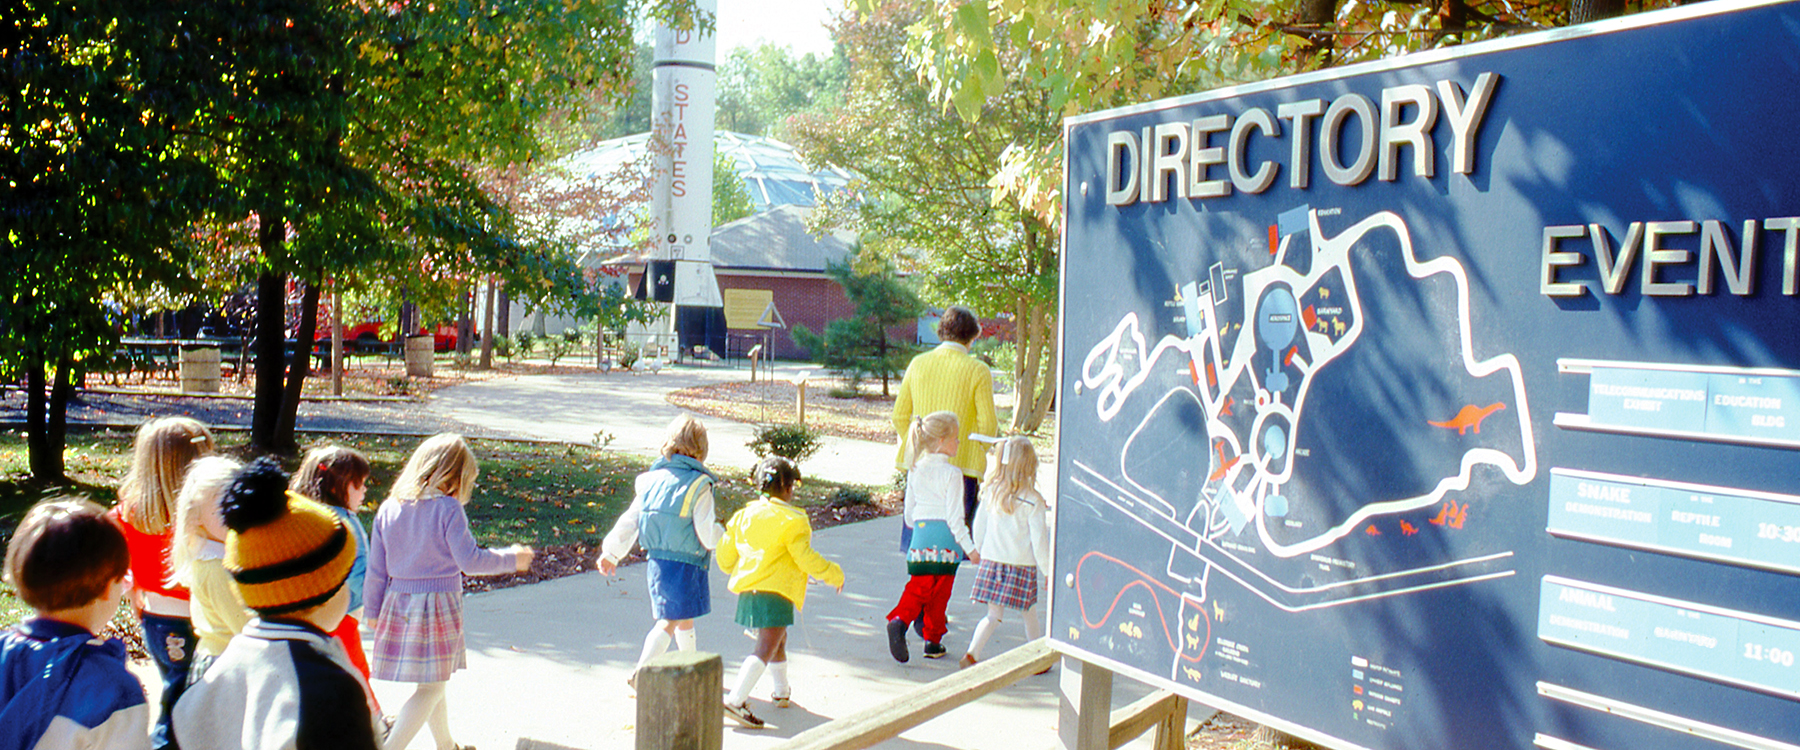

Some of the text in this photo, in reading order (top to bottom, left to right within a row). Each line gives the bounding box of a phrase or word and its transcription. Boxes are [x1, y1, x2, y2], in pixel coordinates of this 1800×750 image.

[672, 83, 690, 198] STATES
[1106, 71, 1501, 206] DIRECTORY
[1714, 394, 1782, 410] EDUCATION
[1751, 414, 1786, 428] BLDG
[1577, 482, 1631, 503] SNAKE
[1565, 501, 1653, 523] DEMONSTRATION
[1671, 510, 1721, 527] REPTILE
[1698, 532, 1733, 548] ROOM
[1559, 587, 1616, 612] ANIMAL
[1549, 614, 1630, 639] DEMONSTRATION
[1743, 642, 1795, 667] 11:00
